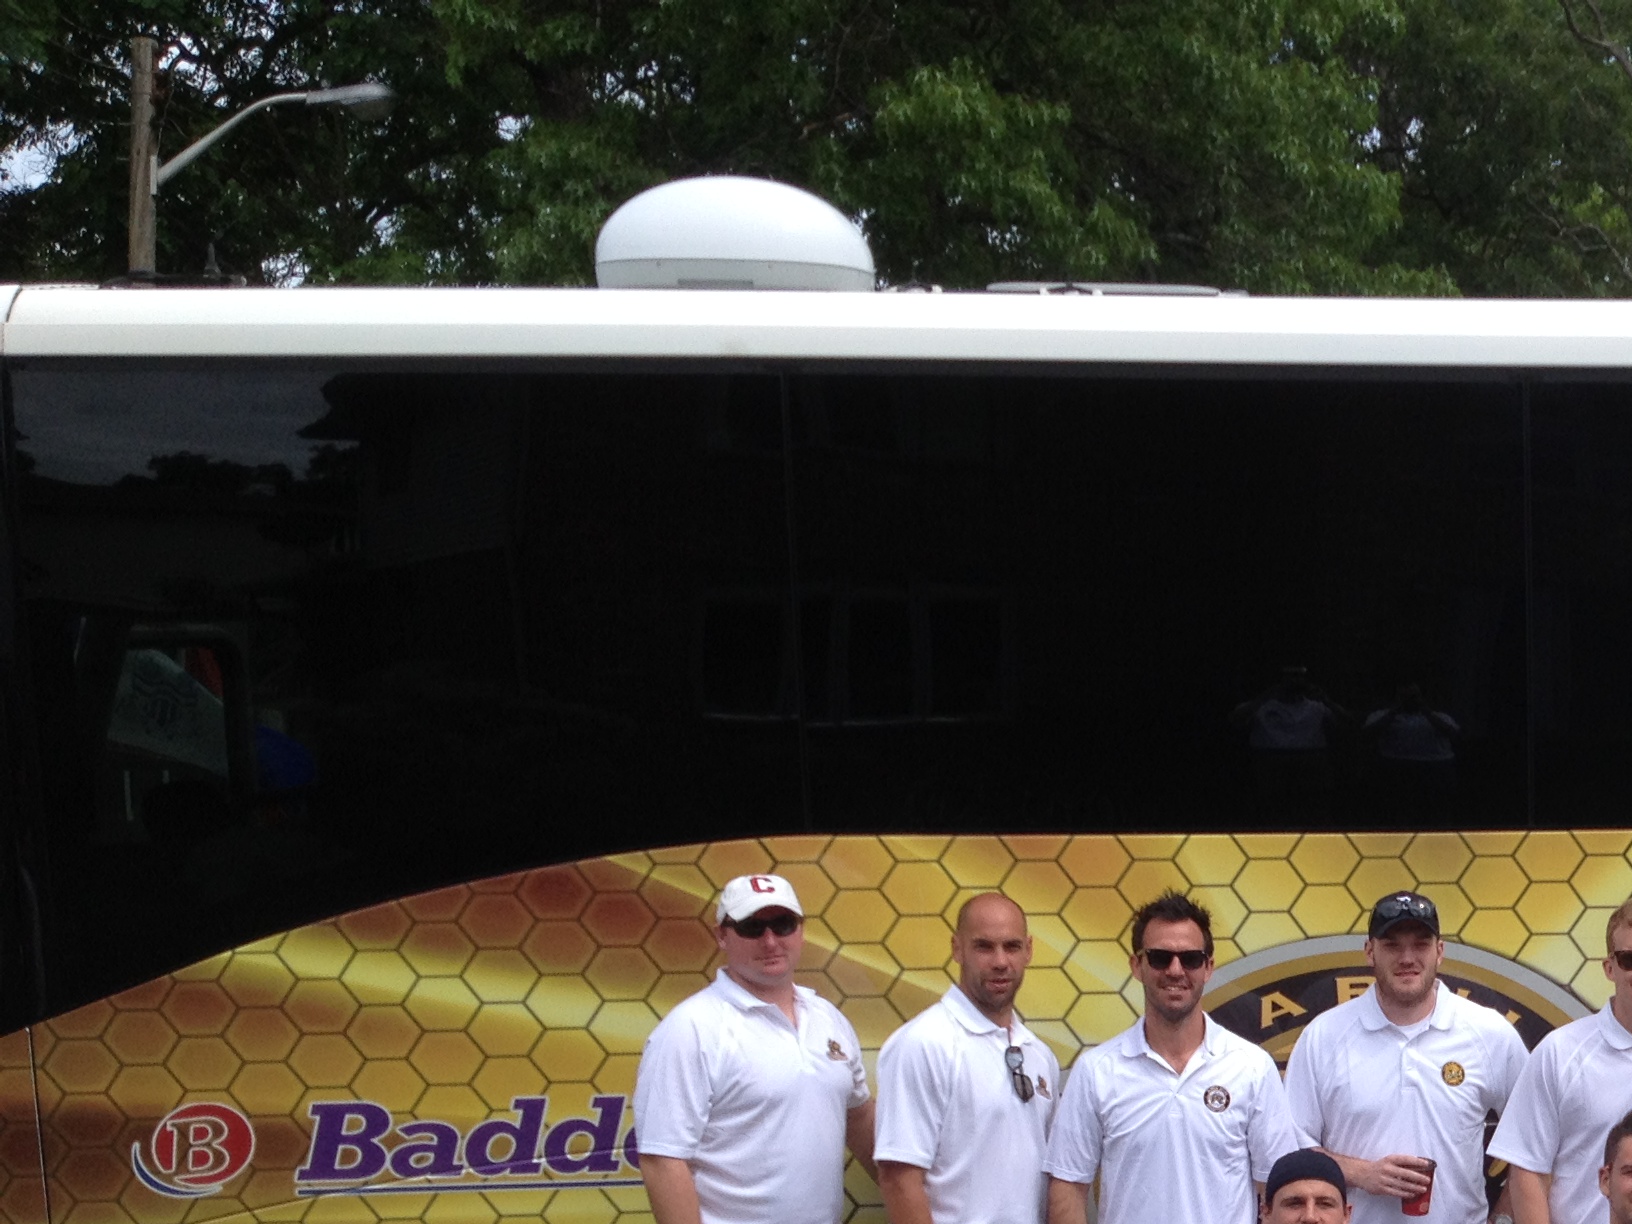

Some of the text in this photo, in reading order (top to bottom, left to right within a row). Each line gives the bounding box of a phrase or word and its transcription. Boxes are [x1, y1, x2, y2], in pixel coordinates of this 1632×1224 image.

[750, 876, 776, 894] C
[165, 1114, 231, 1177] B
[297, 1095, 656, 1184] Badd
